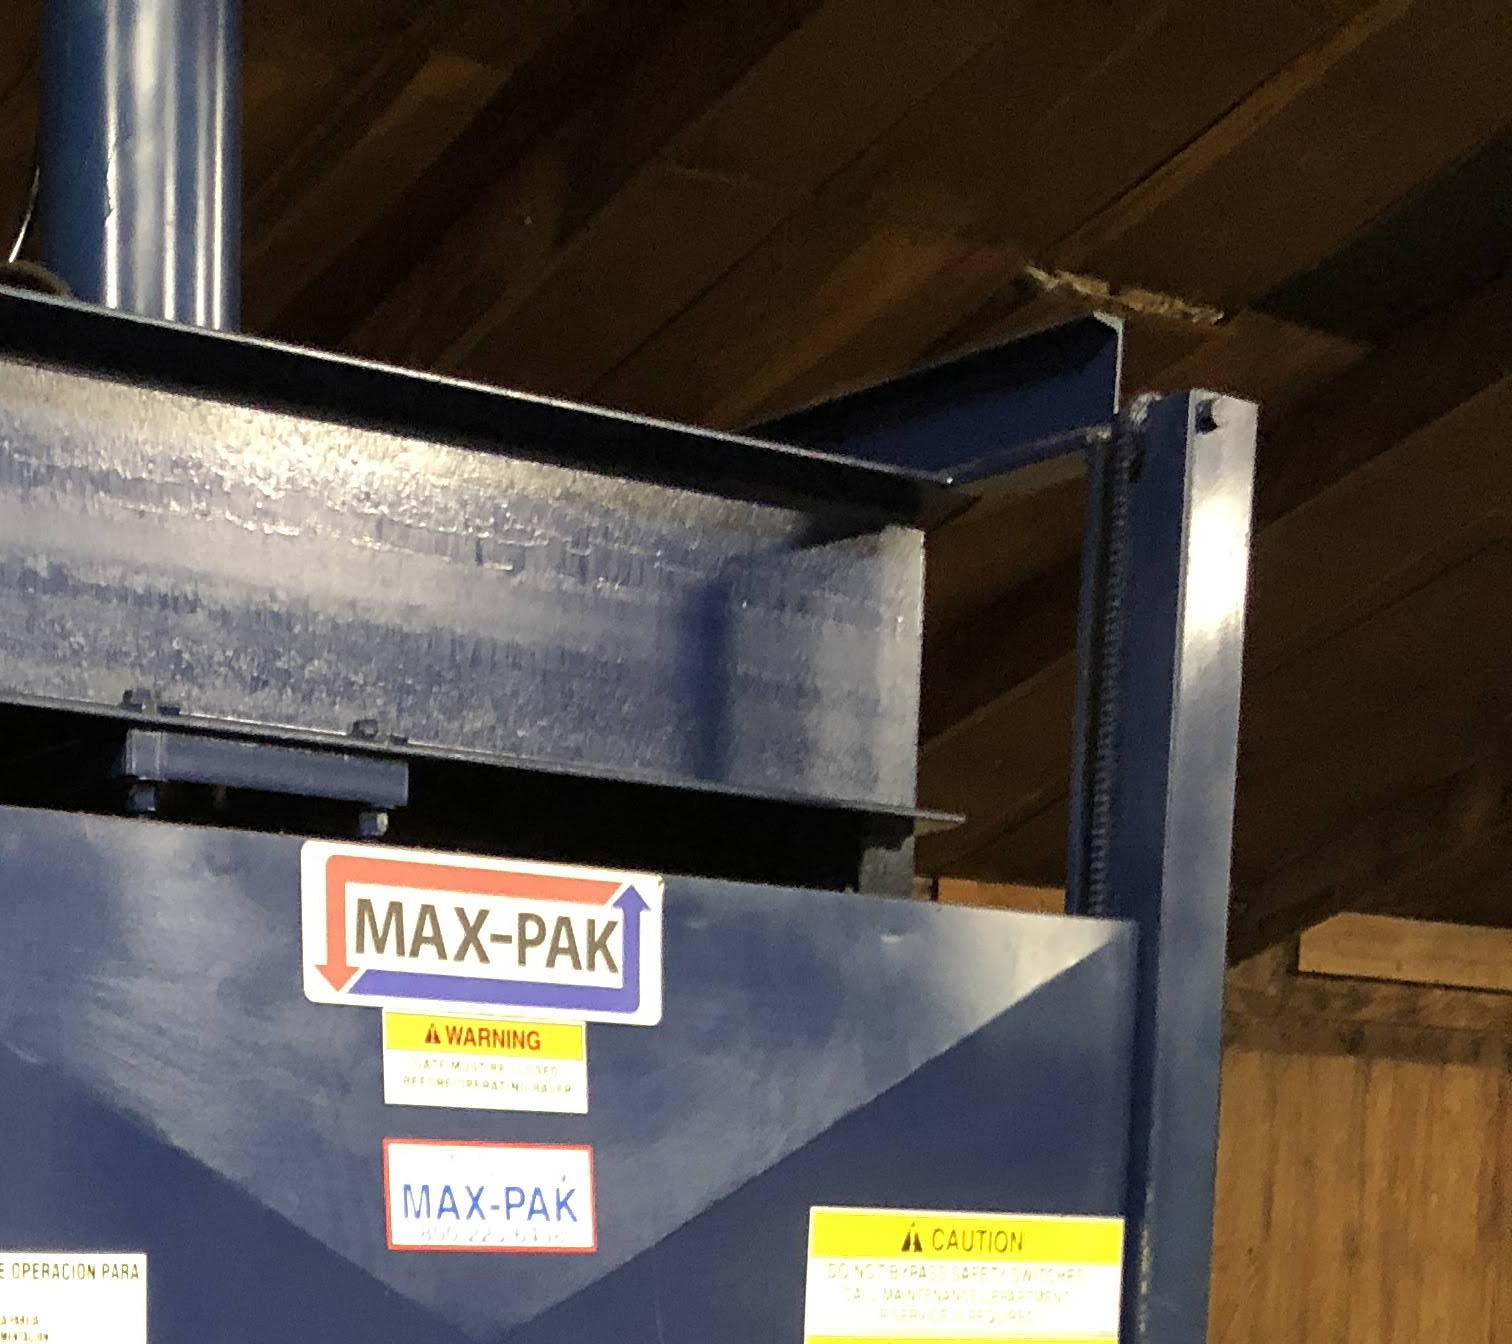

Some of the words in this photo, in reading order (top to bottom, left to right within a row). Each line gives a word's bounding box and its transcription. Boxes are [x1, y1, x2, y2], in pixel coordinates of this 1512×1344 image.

[356, 898, 619, 973] MAX-PAK
[445, 1025, 541, 1051] WARNING
[403, 1184, 578, 1222] MAX-PAK
[932, 1228, 1024, 1253] CAUTION
[12, 1262, 96, 1280] OPERACION
[101, 1263, 139, 1280] PARA
[828, 1263, 848, 1279] DO
[854, 1264, 885, 1280] NOT
[889, 1264, 947, 1280] BYPASS
[952, 1265, 1006, 1281] SAFETY
